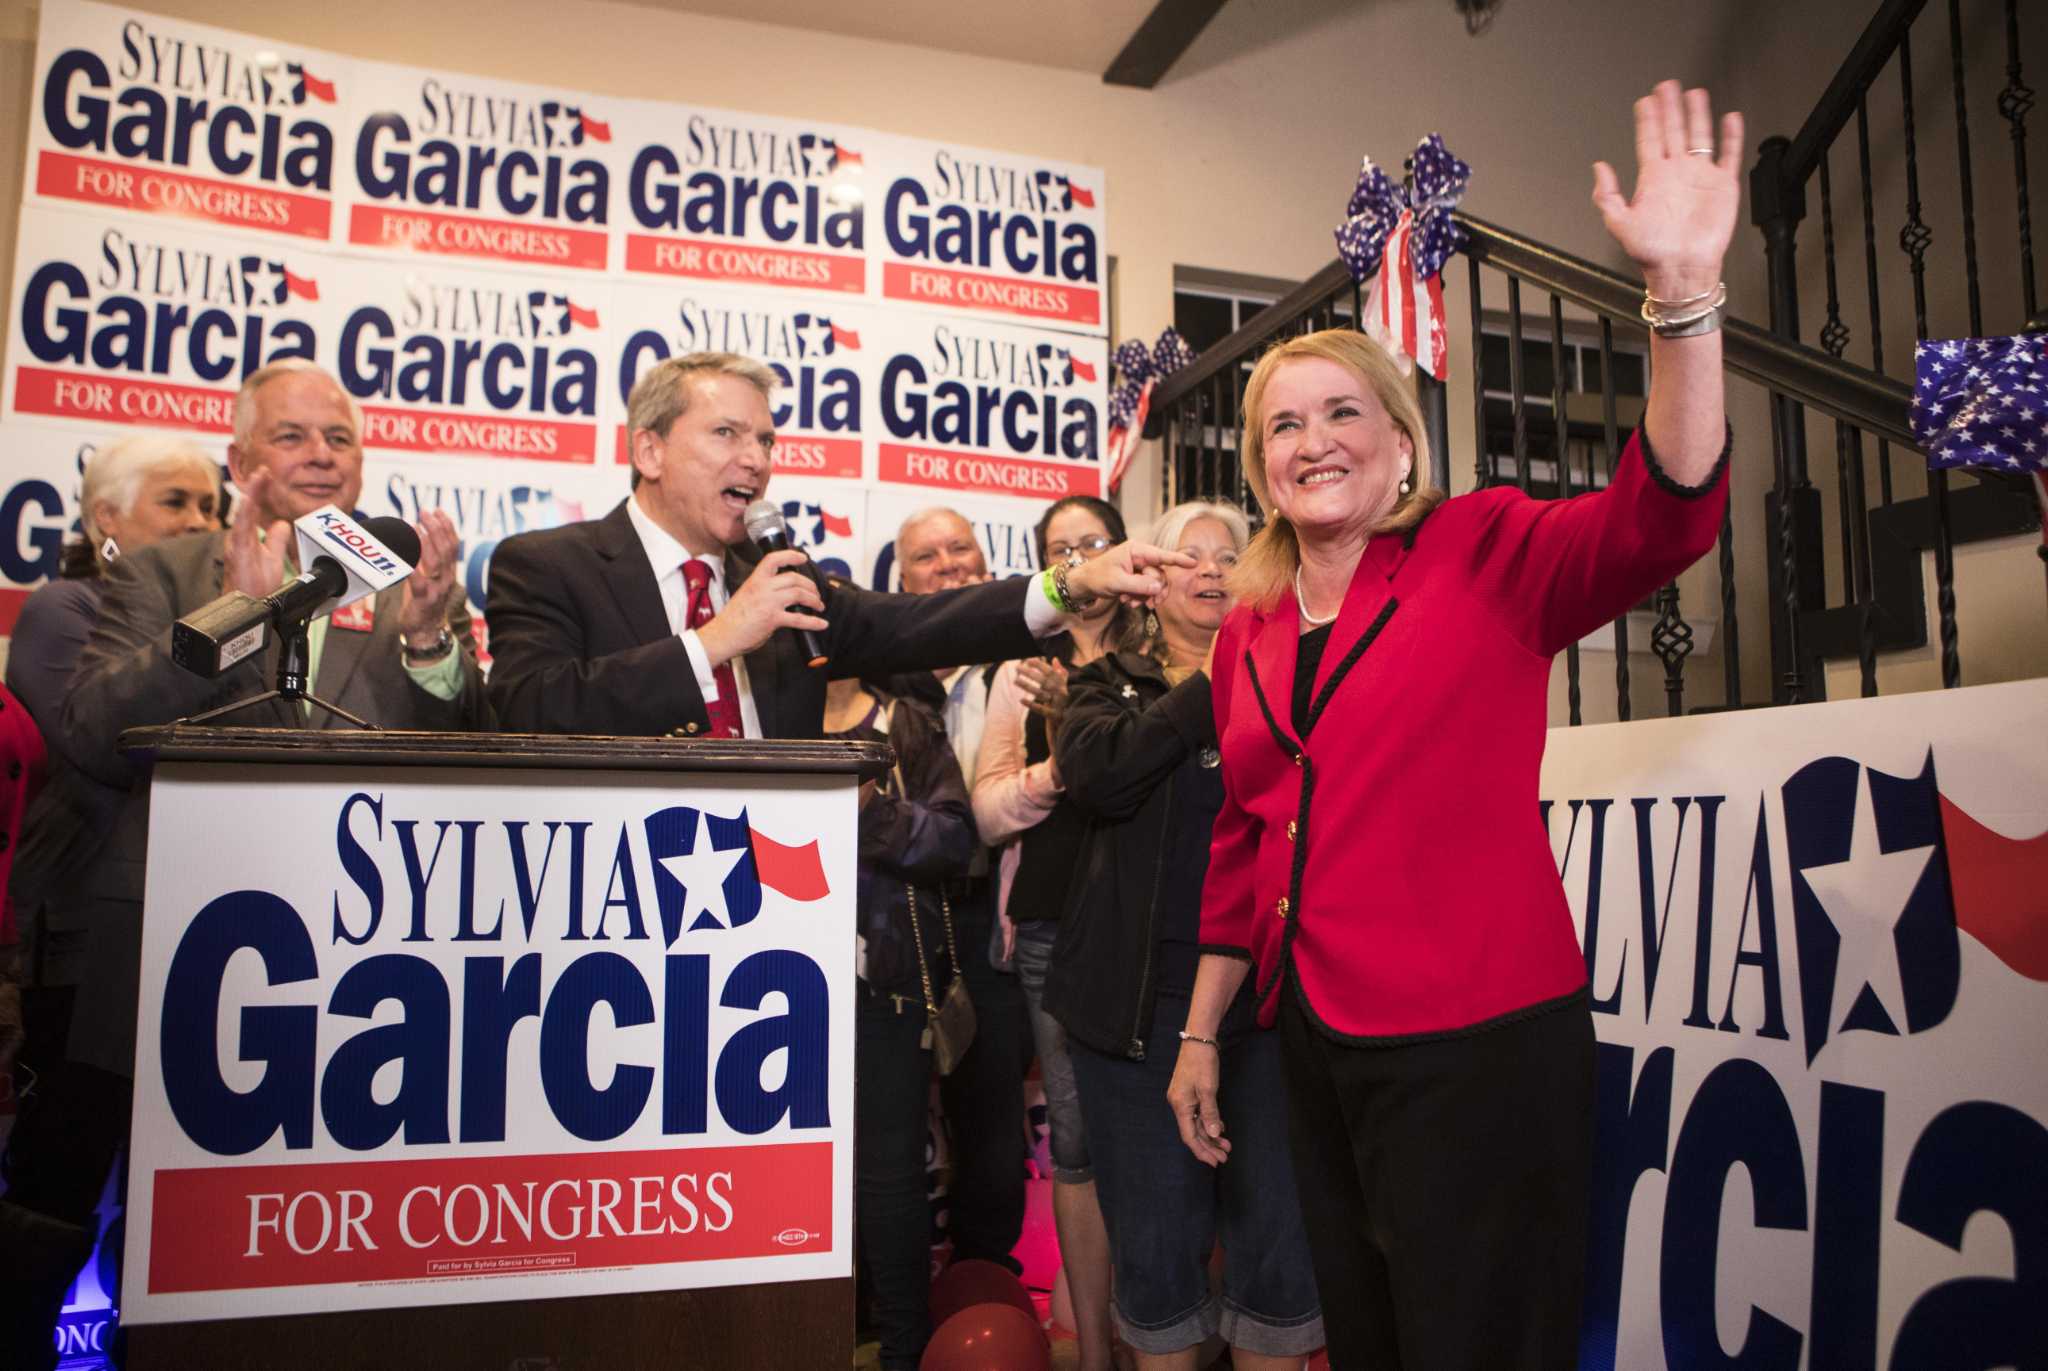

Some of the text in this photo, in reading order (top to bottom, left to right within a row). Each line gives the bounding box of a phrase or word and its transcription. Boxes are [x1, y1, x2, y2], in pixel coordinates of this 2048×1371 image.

[119, 19, 255, 103] SYLVIA
[43, 48, 334, 191] Garcia
[418, 78, 538, 147] SYLVIA
[686, 114, 797, 177] SYLVIA
[77, 164, 291, 225] FOR CONGRESS
[355, 110, 610, 225] Garcia
[628, 144, 864, 250] Garcia
[934, 149, 1036, 213] SYLVIA
[381, 214, 572, 259] FOR CONGRESS
[655, 242, 831, 282] FOR CONGRESS
[883, 176, 1099, 284] Garcia
[98, 228, 236, 306] SYLVIA
[909, 271, 1070, 314] FOR CONGRESS
[21, 260, 316, 383] Garcia
[402, 275, 525, 338] SYLVIA
[677, 297, 792, 359] SYLVIA
[338, 305, 598, 417] Garcia
[618, 329, 862, 432] Gcia
[932, 324, 1036, 388] SYLVIA
[54, 378, 233, 426] FOR CONGR
[364, 413, 559, 455] FOR CONGRESS
[879, 353, 1099, 462] Garcia
[770, 441, 827, 469] RESS
[906, 452, 1069, 494] FOR CONGRESS
[332, 792, 651, 947] SYLVIA
[1539, 790, 1791, 1042] LVIA
[160, 889, 831, 1157] Garcia
[244, 1171, 735, 1258] FOR CONGRESS
[1578, 1041, 2048, 1371] rcia
[432, 1263, 450, 1271] Paid
[451, 1262, 462, 1270] for
[463, 1261, 473, 1271] by
[474, 1260, 497, 1270] Sylvia
[498, 1259, 522, 1267] Garcia
[535, 1256, 572, 1266] Congress
